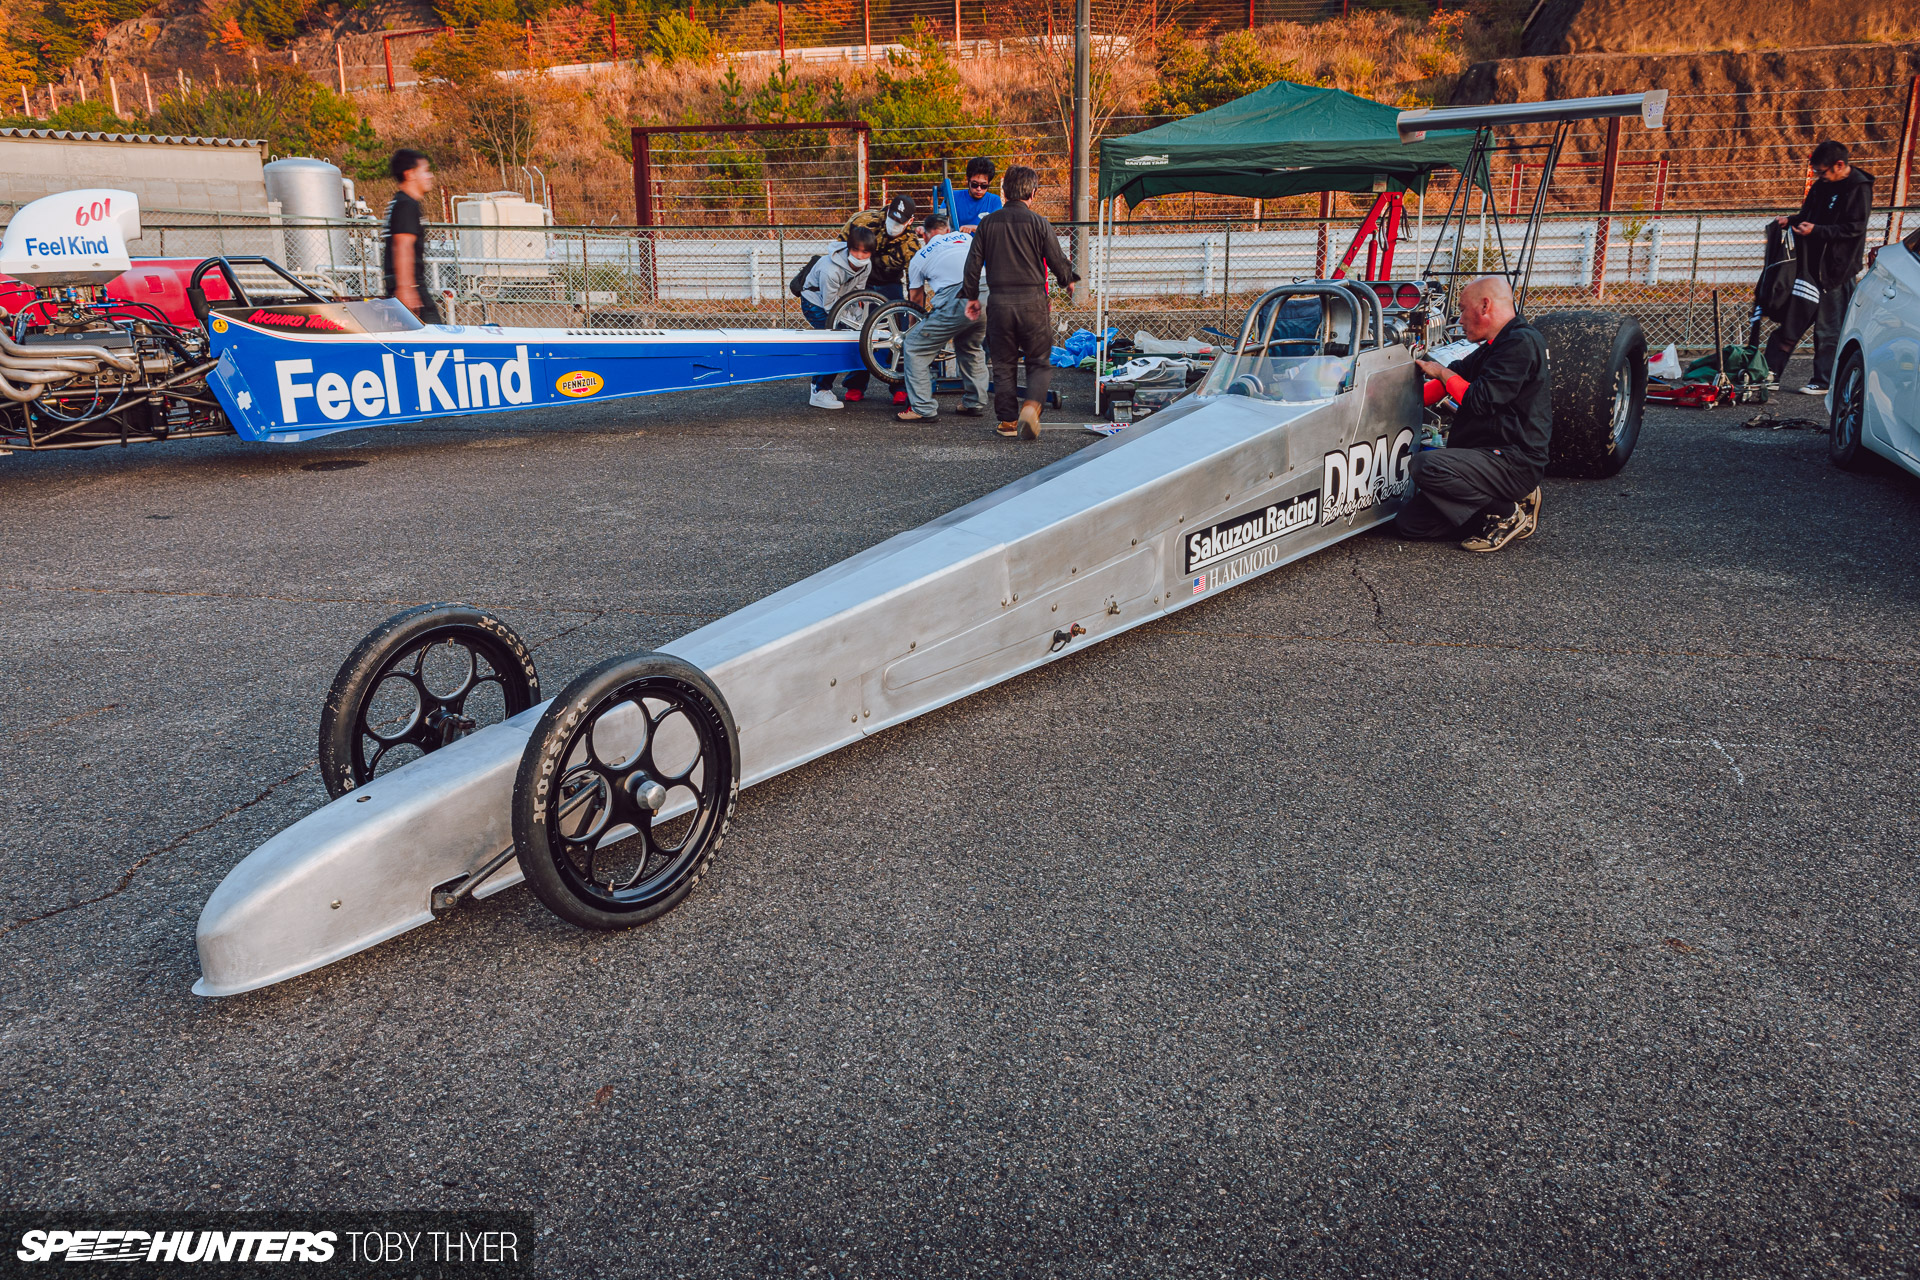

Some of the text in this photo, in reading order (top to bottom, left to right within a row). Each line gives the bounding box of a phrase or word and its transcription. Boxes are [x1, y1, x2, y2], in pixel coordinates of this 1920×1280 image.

[75, 198, 111, 226] 601
[25, 235, 109, 256] Feel Kind
[275, 345, 533, 424] Feel Kind
[562, 376, 597, 391] PENNZOIL
[1322, 426, 1414, 522] DRAG
[1189, 496, 1318, 565] Sakuzou Racing
[1208, 543, 1279, 592] H.AKIMOTO
